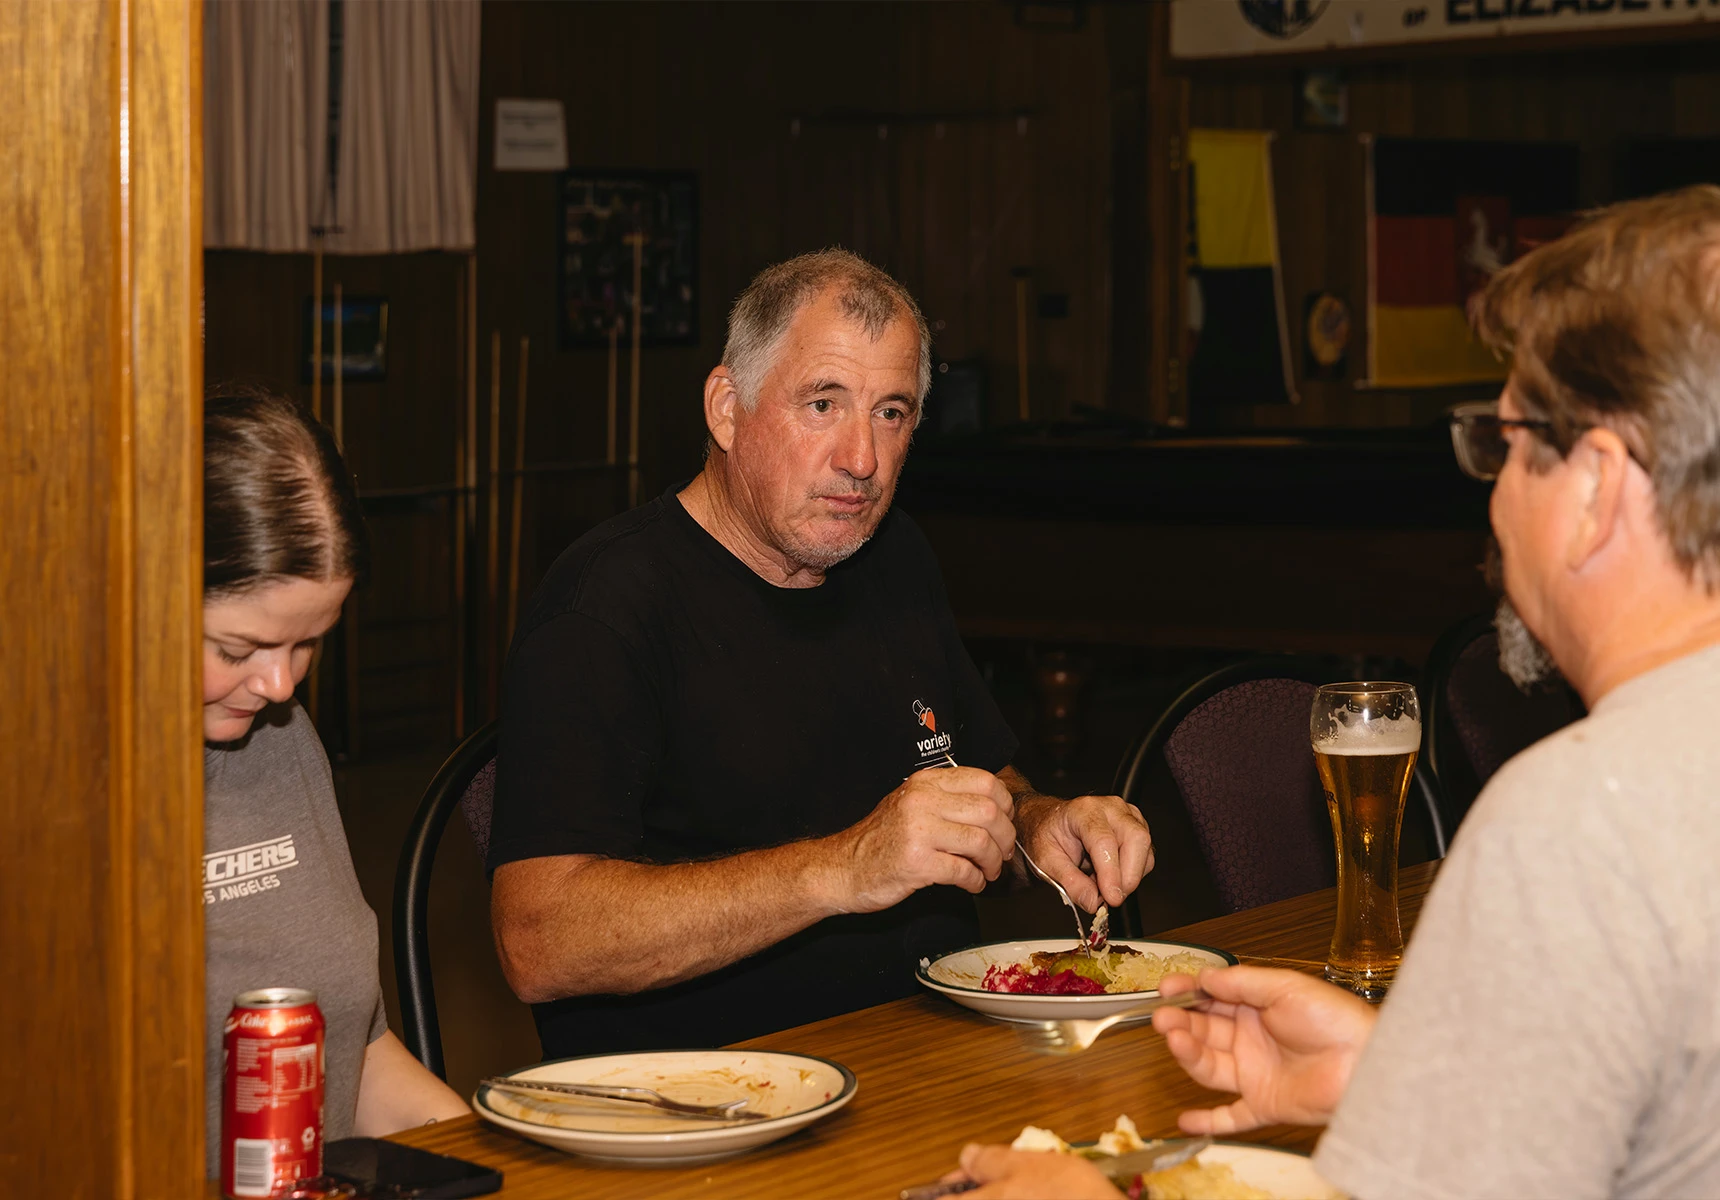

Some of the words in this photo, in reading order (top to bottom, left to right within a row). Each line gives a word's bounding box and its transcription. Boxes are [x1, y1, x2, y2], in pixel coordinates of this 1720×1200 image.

[916, 731, 952, 752] variety
[202, 840, 296, 883] CHERS
[219, 874, 281, 901] ANGELES
